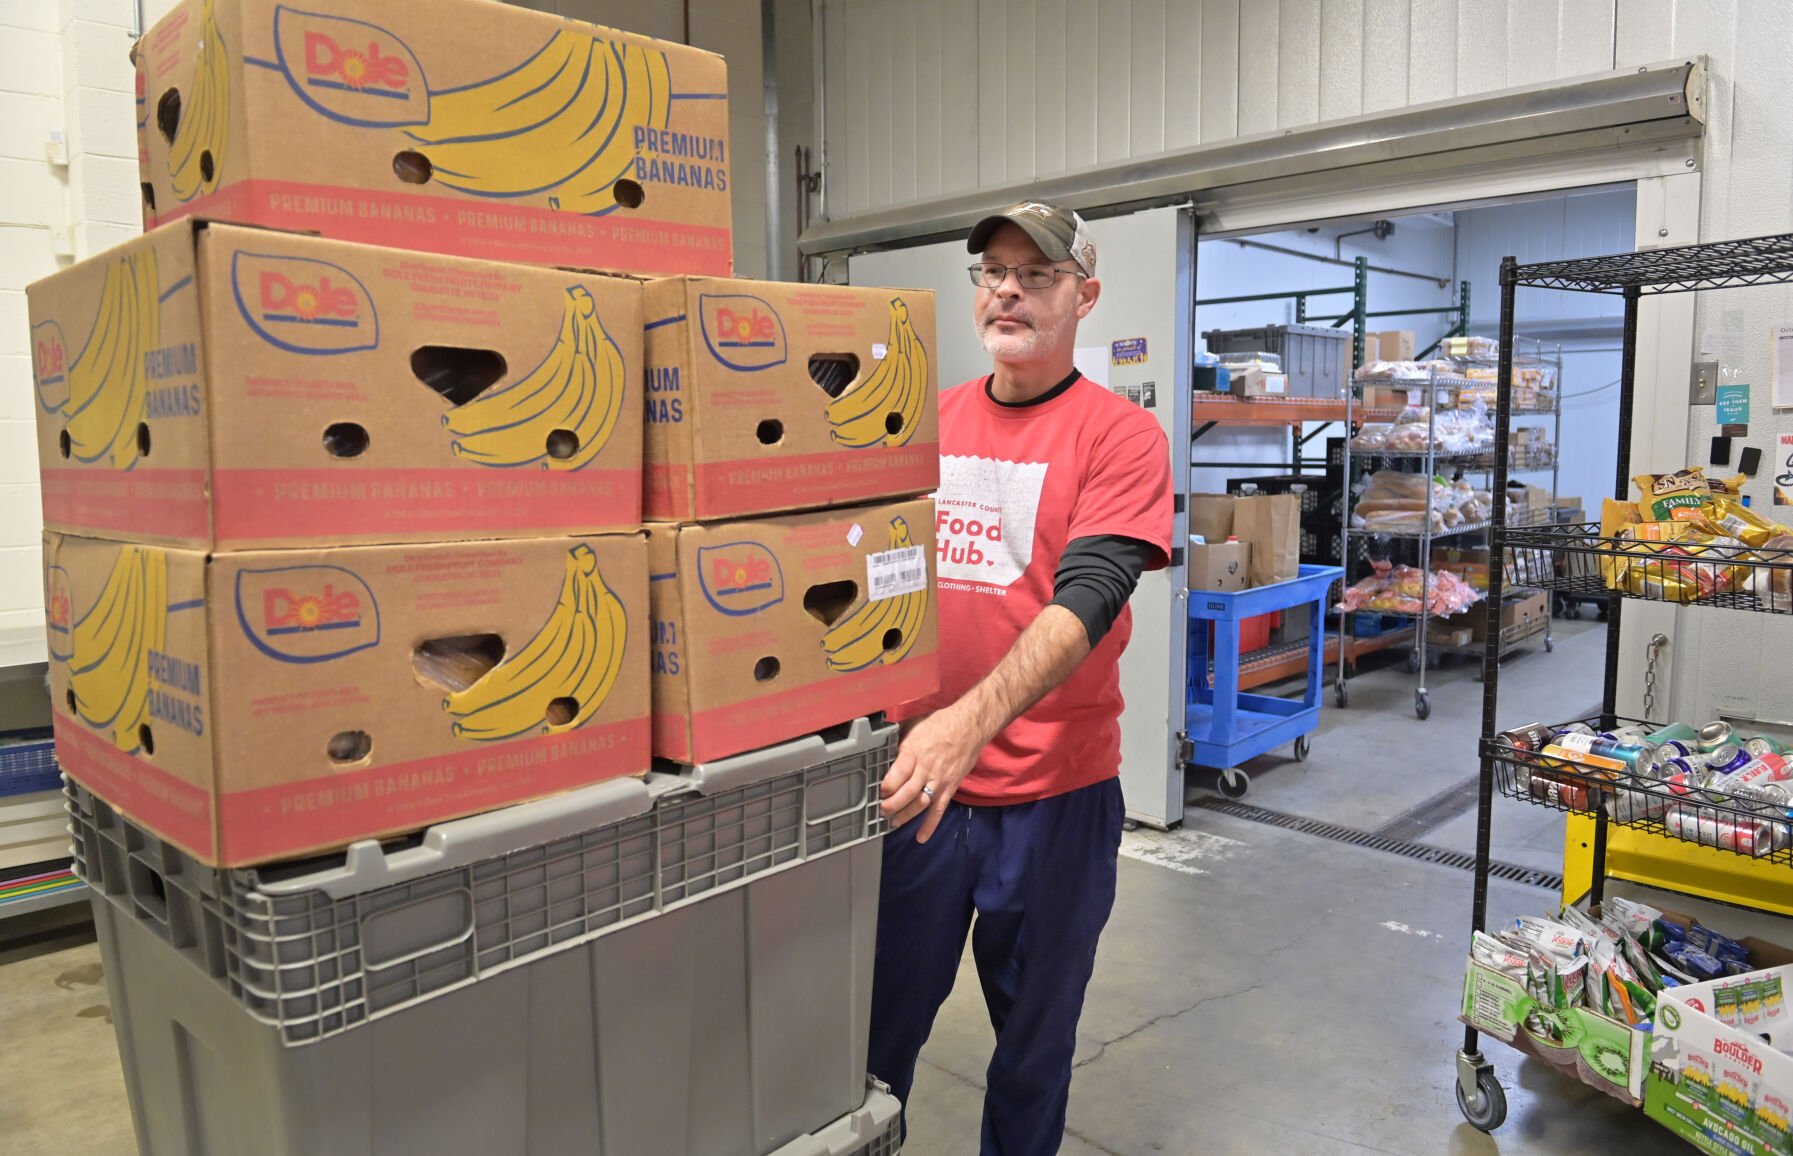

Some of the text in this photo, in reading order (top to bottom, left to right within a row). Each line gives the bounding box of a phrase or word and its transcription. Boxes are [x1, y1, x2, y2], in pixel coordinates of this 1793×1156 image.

[304, 30, 409, 89] Dole
[634, 125, 725, 163] PREMIUM
[635, 156, 727, 192] BANANAS
[270, 192, 353, 216] PREMIUM
[359, 201, 436, 224] BANANAS
[457, 209, 526, 233] PREMIUM
[530, 214, 595, 239] BANANAS
[612, 227, 669, 246] PREMIUM
[671, 232, 726, 251] BANANAS
[260, 271, 359, 318] Dole
[716, 307, 776, 341] Dole
[144, 341, 197, 381] PREMIUM
[644, 366, 681, 393] IUM
[145, 382, 201, 419] BANANAS
[645, 397, 684, 424] NAS
[274, 480, 613, 501] PREMIUM BANANAS PREMIUM BANANAS
[938, 498, 977, 508] LANCASTER
[1663, 497, 1702, 508] FAMILY
[936, 510, 1002, 542] Food
[712, 552, 771, 588] Dole
[936, 538, 984, 566] Hub
[263, 583, 361, 627] Dole
[937, 581, 1007, 597] CLOTHING SHELTER
[147, 648, 201, 697] PREMIUM
[148, 687, 204, 737] BANANAS
[280, 782, 369, 816] PREMIUM
[374, 765, 456, 797] BANANAS
[477, 748, 548, 776] PREMIUM
[551, 733, 616, 761] BANANAS
[1713, 1037, 1763, 1076] BOULDER
[1703, 1117, 1755, 1154] AVOCADO OIL
